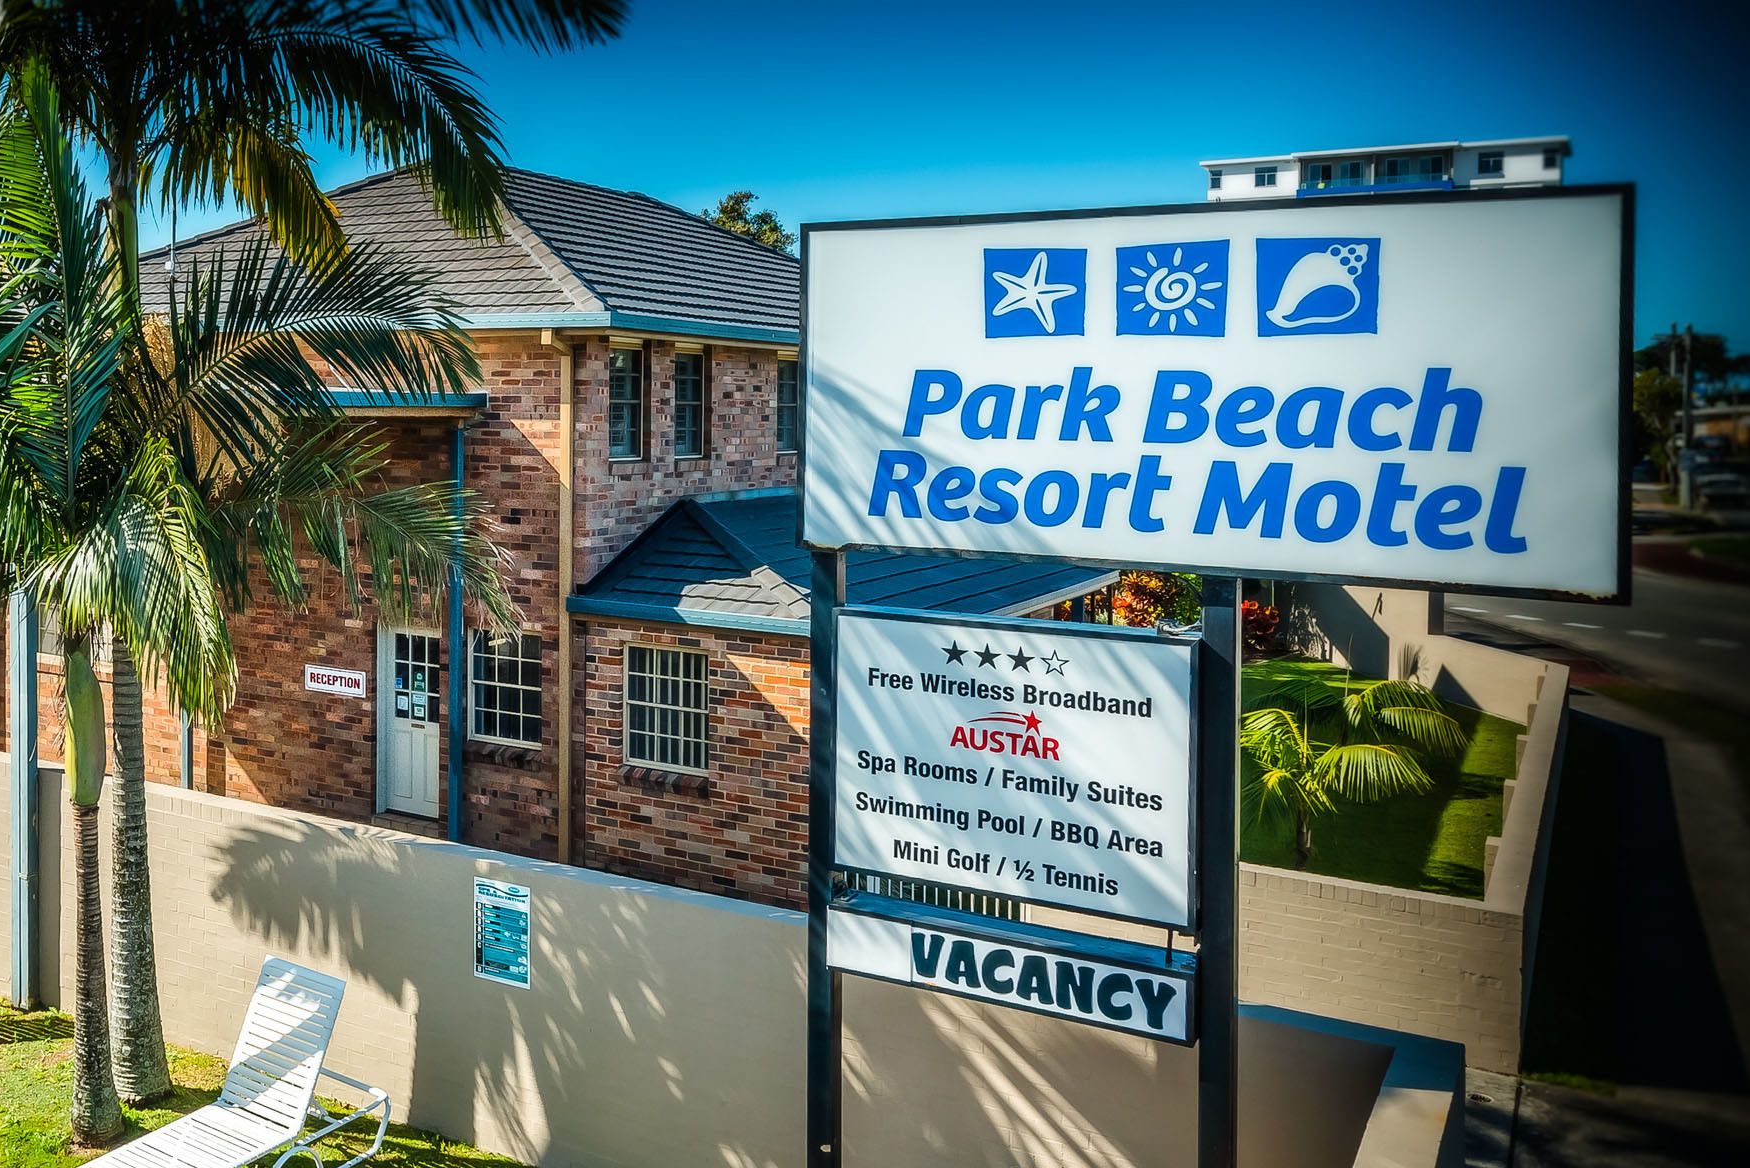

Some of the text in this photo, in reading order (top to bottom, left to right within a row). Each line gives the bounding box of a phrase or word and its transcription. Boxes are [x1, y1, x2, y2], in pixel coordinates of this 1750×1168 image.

[901, 367, 1482, 452] Park Beach
[868, 449, 1527, 553] Resort Motel
[310, 672, 360, 689] RECEPTION
[869, 668, 1151, 718] Free Wireless Broadband
[950, 727, 1059, 760] AUSTAR
[858, 751, 1162, 810] Spa Rooms / Family Suites
[856, 792, 1162, 857] Swimming Pool / BBQ Area
[894, 840, 938, 865] Mini
[948, 849, 990, 873] Golf
[996, 857, 1006, 876] /
[1042, 864, 1118, 895] Tennis
[478, 890, 526, 904] RESUSCITATION
[911, 933, 1176, 1030] VACANCY
